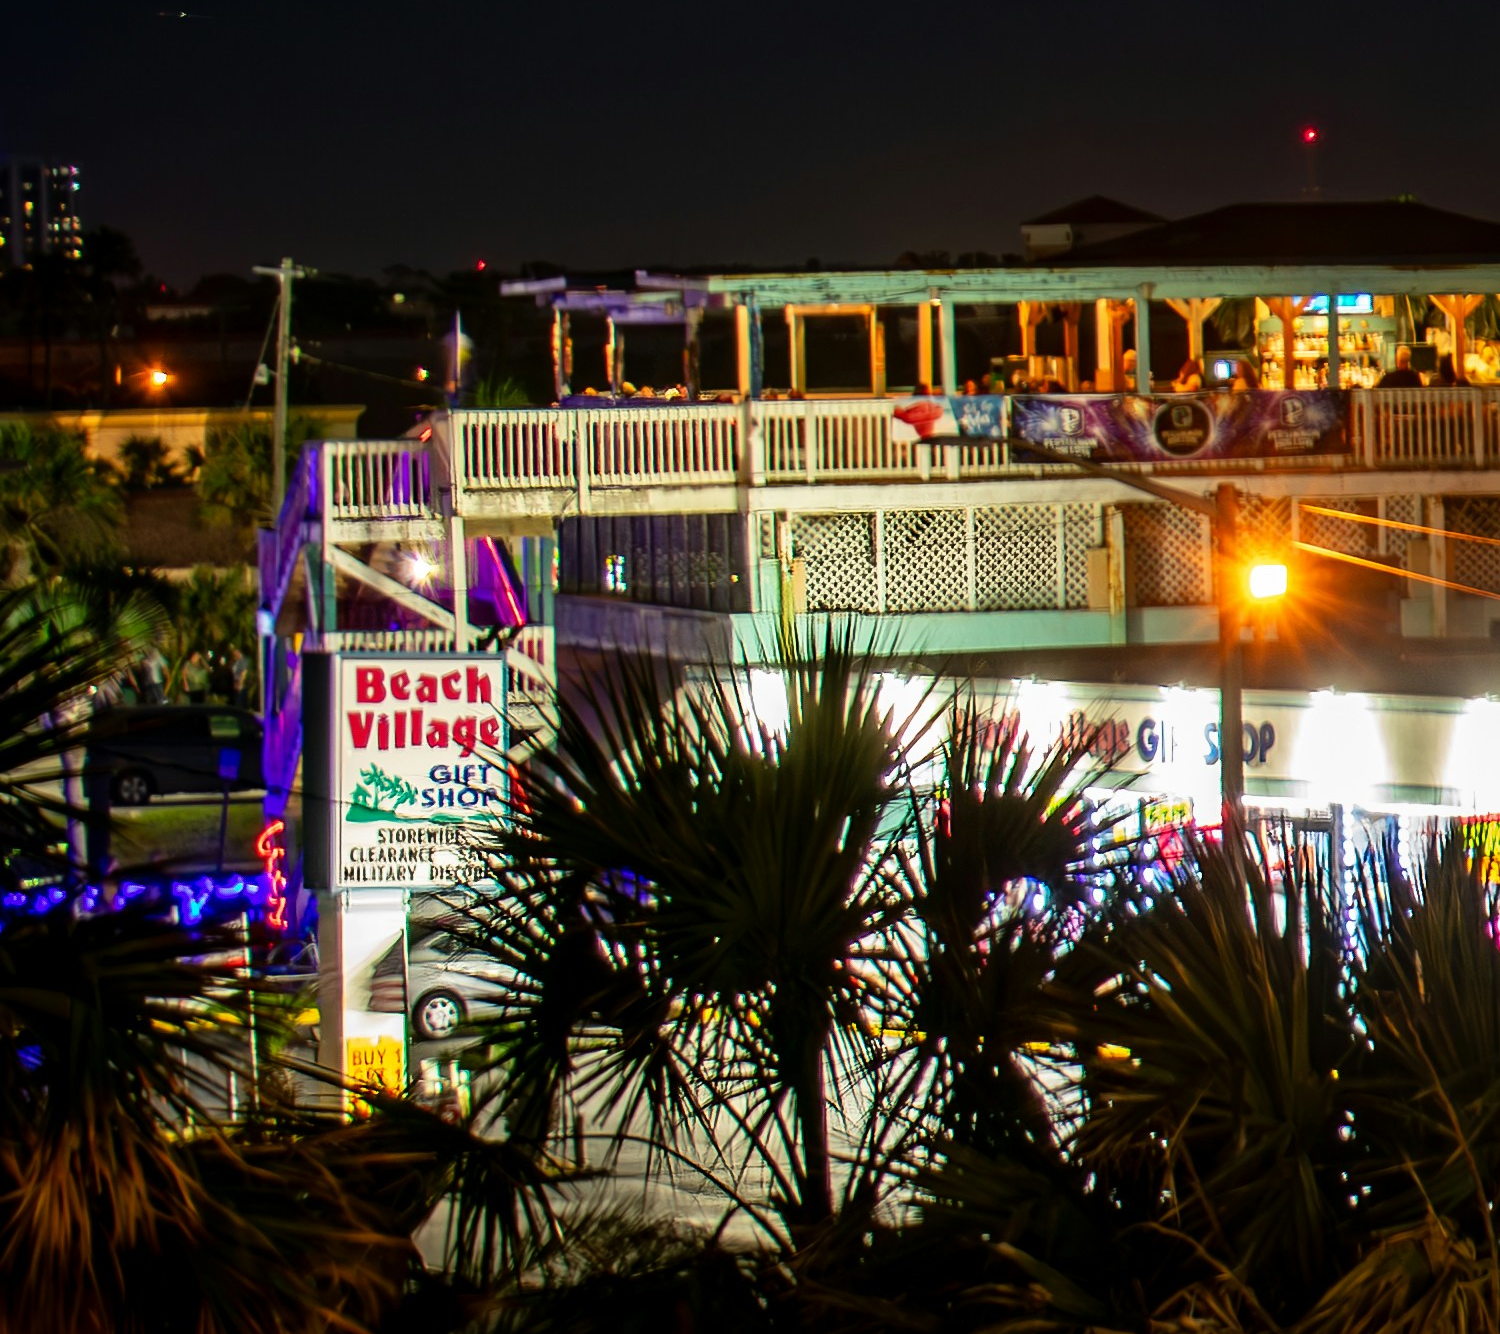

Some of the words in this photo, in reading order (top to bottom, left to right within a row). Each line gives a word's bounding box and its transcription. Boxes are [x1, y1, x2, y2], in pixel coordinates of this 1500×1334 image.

[355, 665, 492, 704] Beach
[347, 708, 500, 758] Village
[1204, 721, 1275, 766] SOP
[428, 764, 494, 785] GIFT
[421, 788, 497, 808] SHOP
[343, 866, 416, 883] MILITARY
[353, 1049, 386, 1066] BUY
